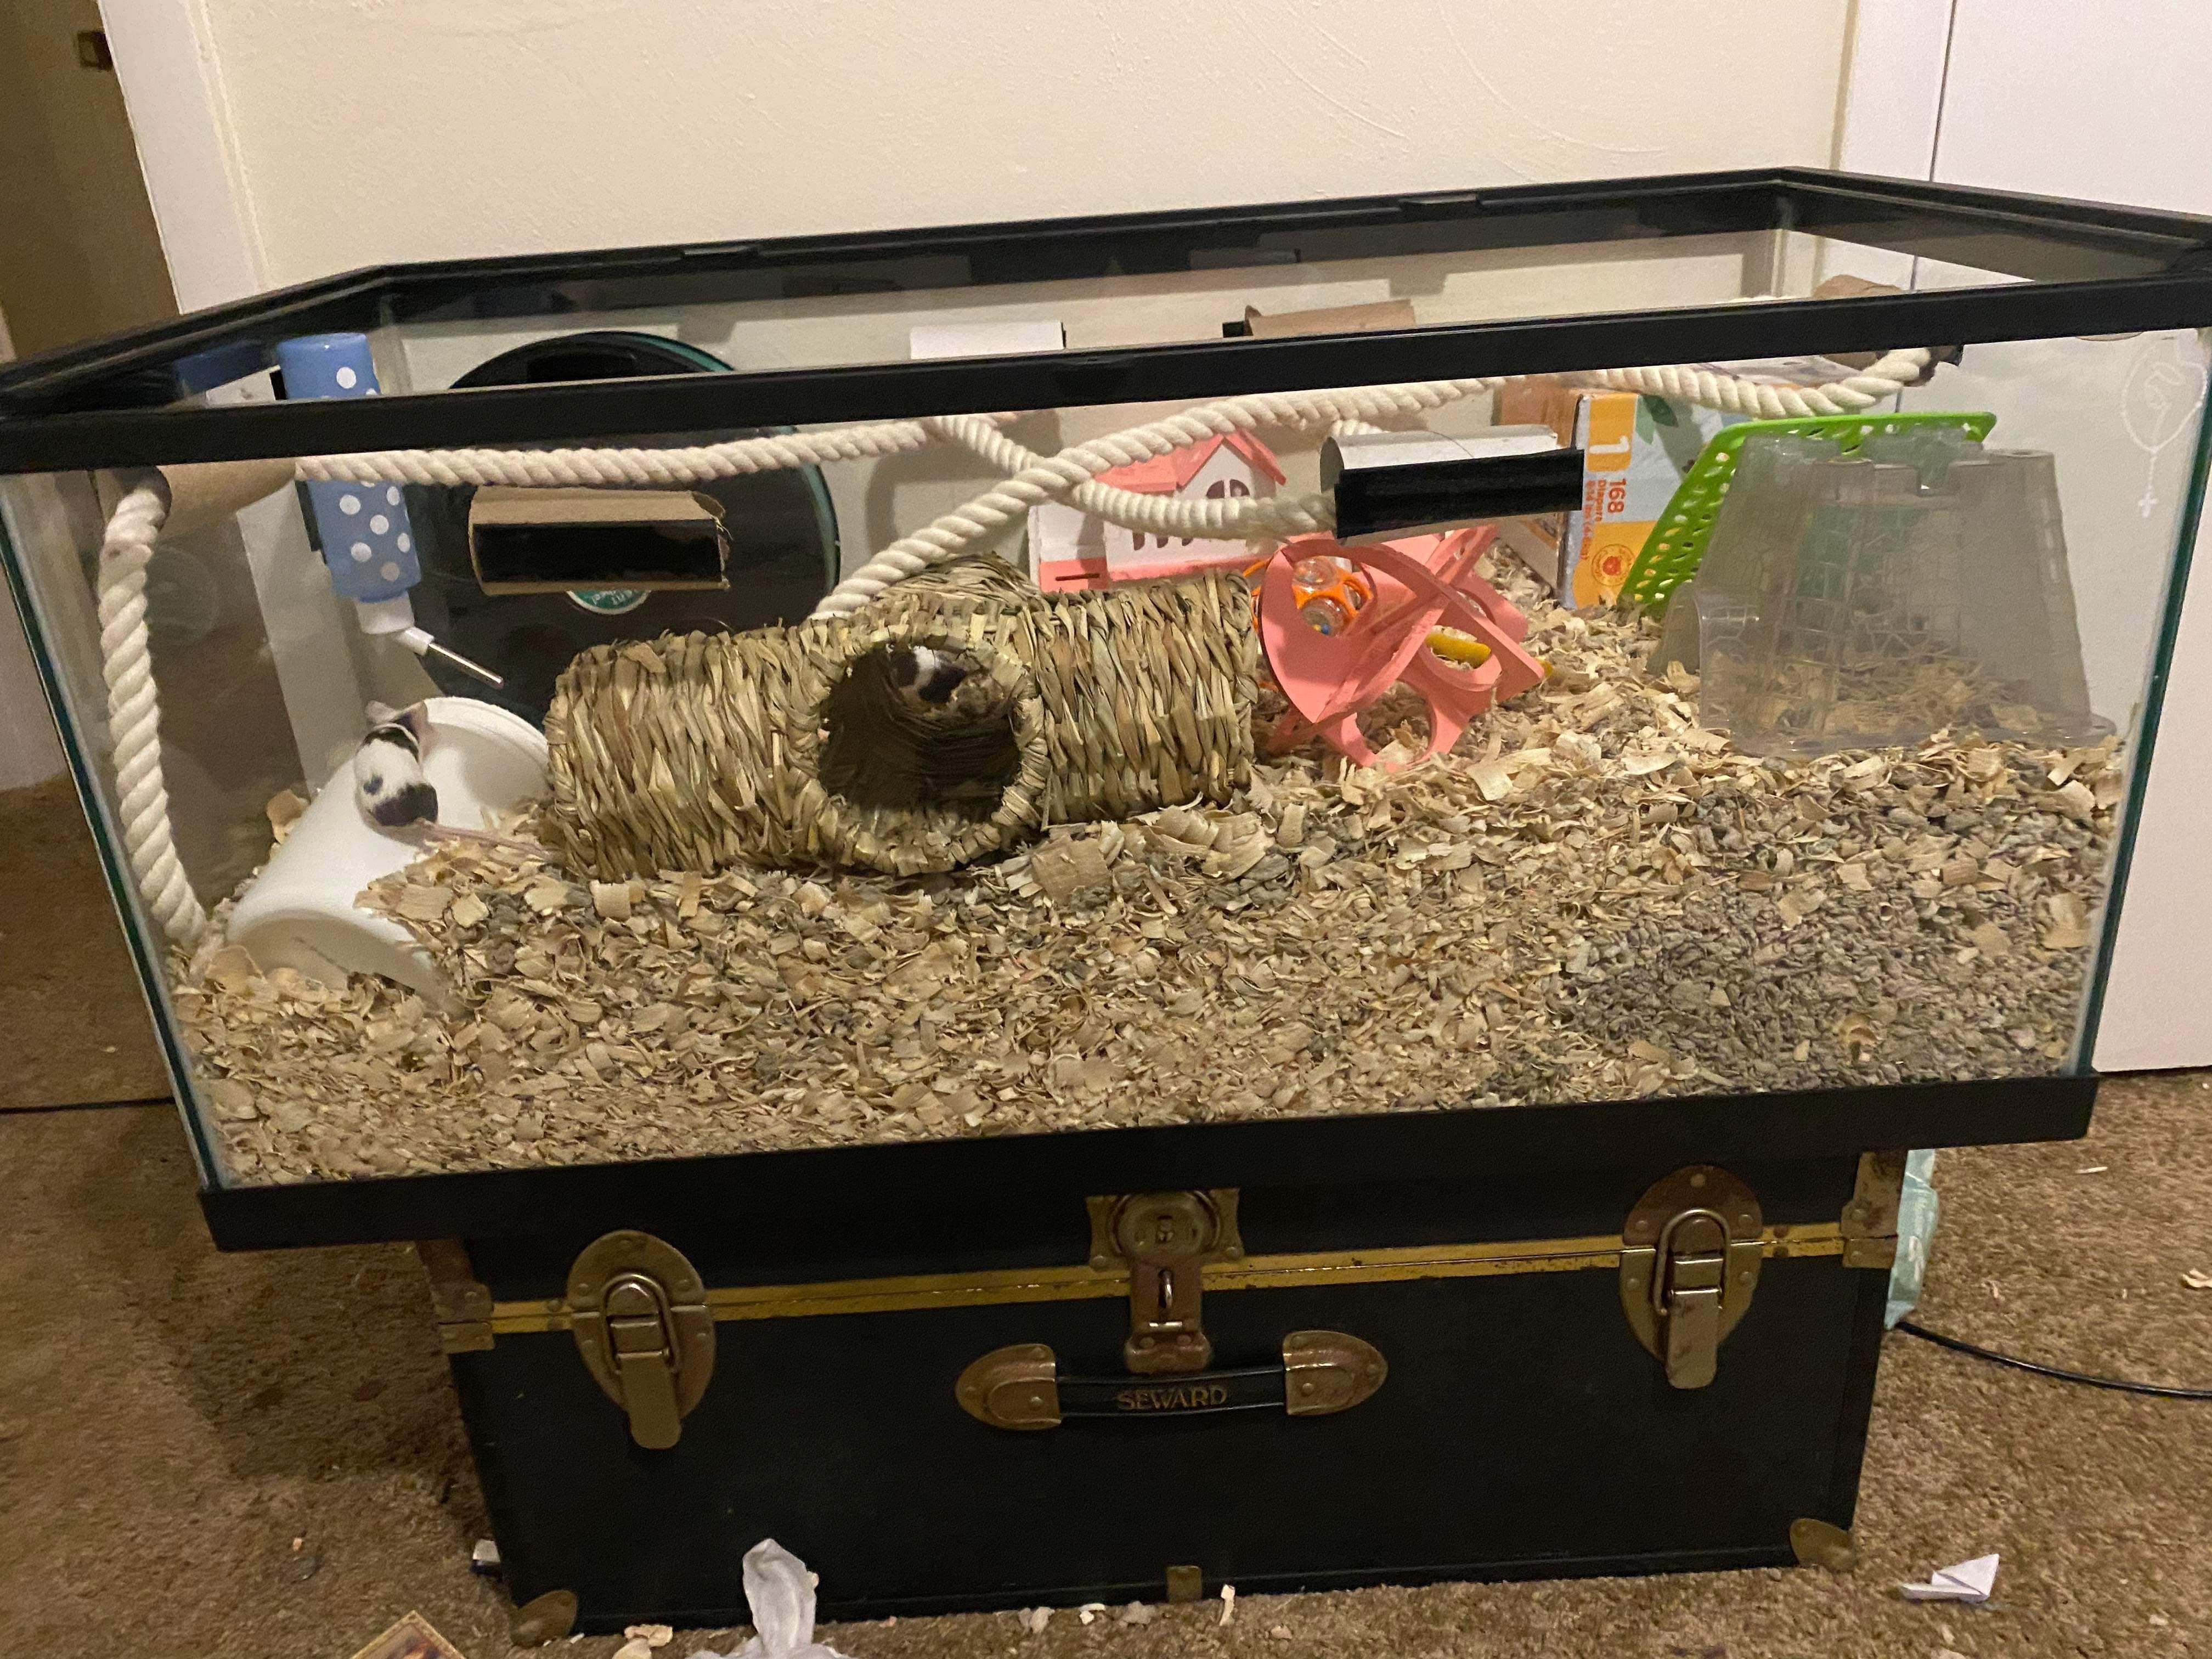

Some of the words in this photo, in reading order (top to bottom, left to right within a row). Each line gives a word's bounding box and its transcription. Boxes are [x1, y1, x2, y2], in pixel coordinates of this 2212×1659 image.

[1589, 435, 1629, 454] 1
[1595, 479, 1606, 522] Diapers
[1607, 478, 1626, 514] 168
[1115, 1385, 1228, 1410] SEWARD
